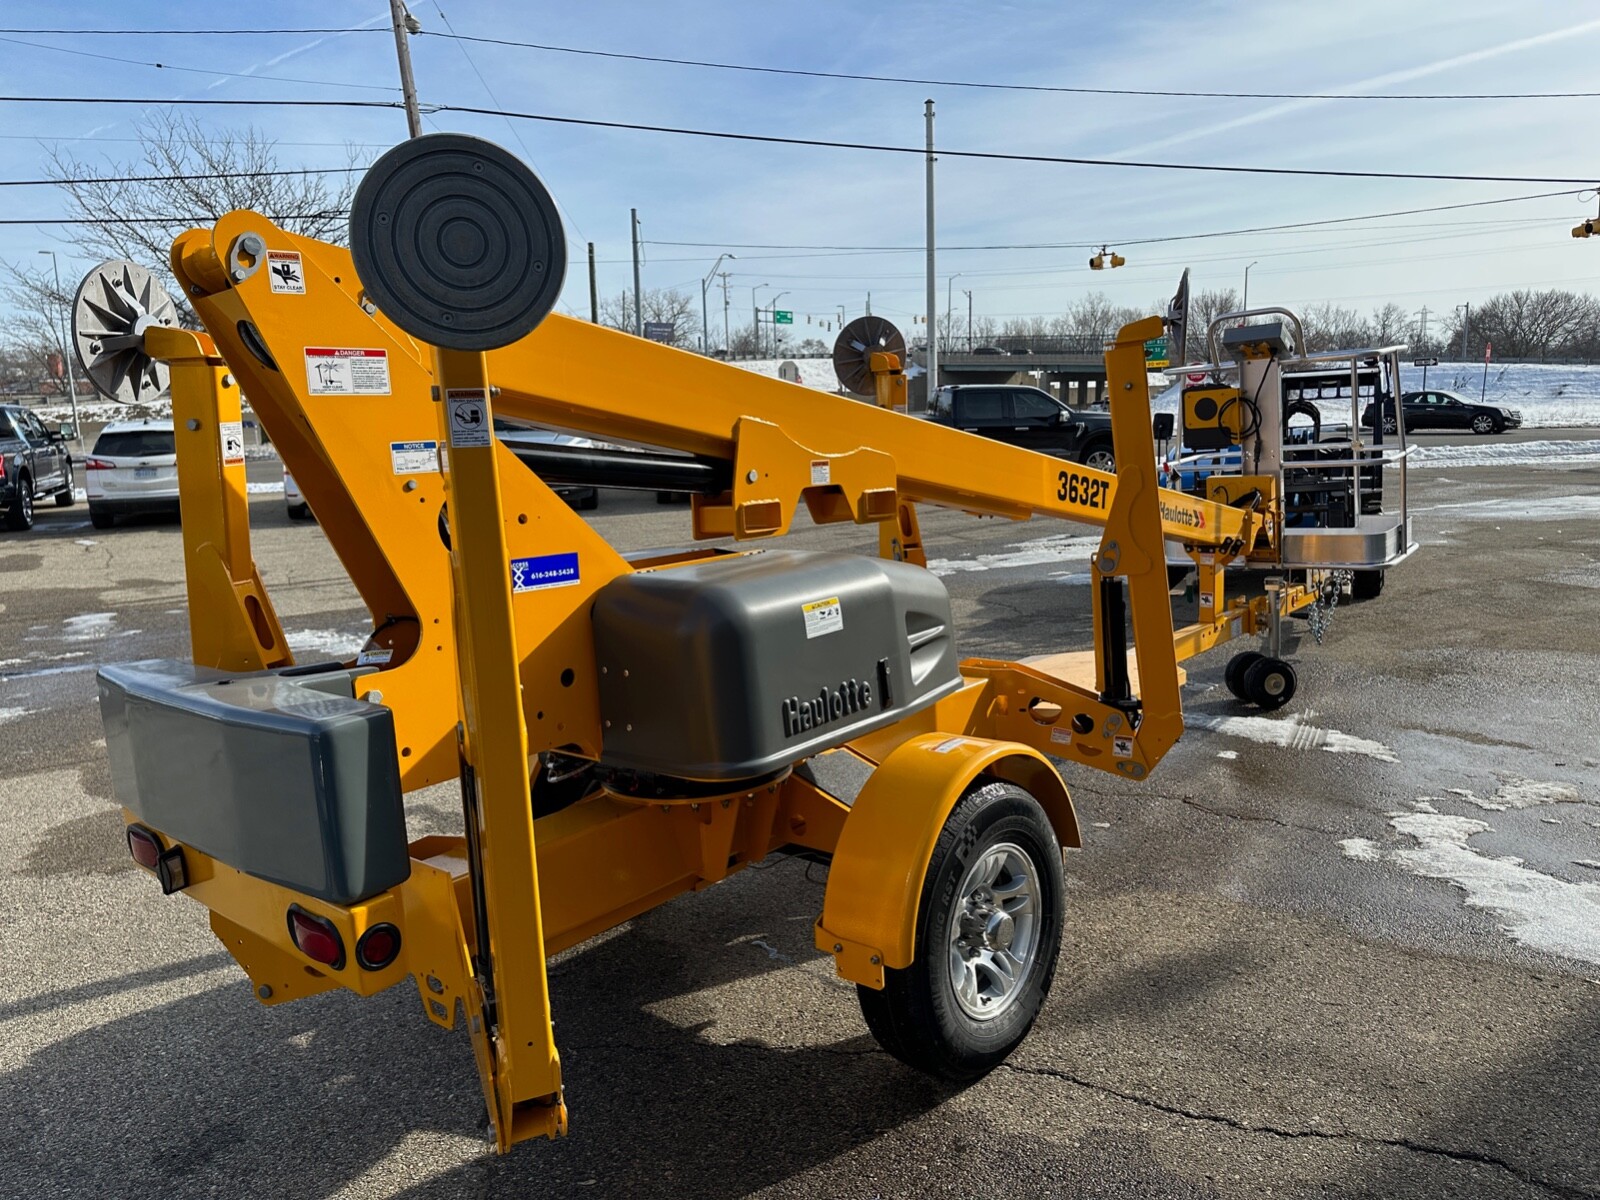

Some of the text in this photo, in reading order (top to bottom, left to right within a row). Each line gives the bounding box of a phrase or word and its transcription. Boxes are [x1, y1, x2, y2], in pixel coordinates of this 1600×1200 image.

[1057, 470, 1110, 509] 3632T
[1160, 501, 1193, 527] Haulotte
[531, 568, 574, 580] 616-248-5438
[781, 677, 873, 739] Haulotte
[942, 870, 957, 907] RST
